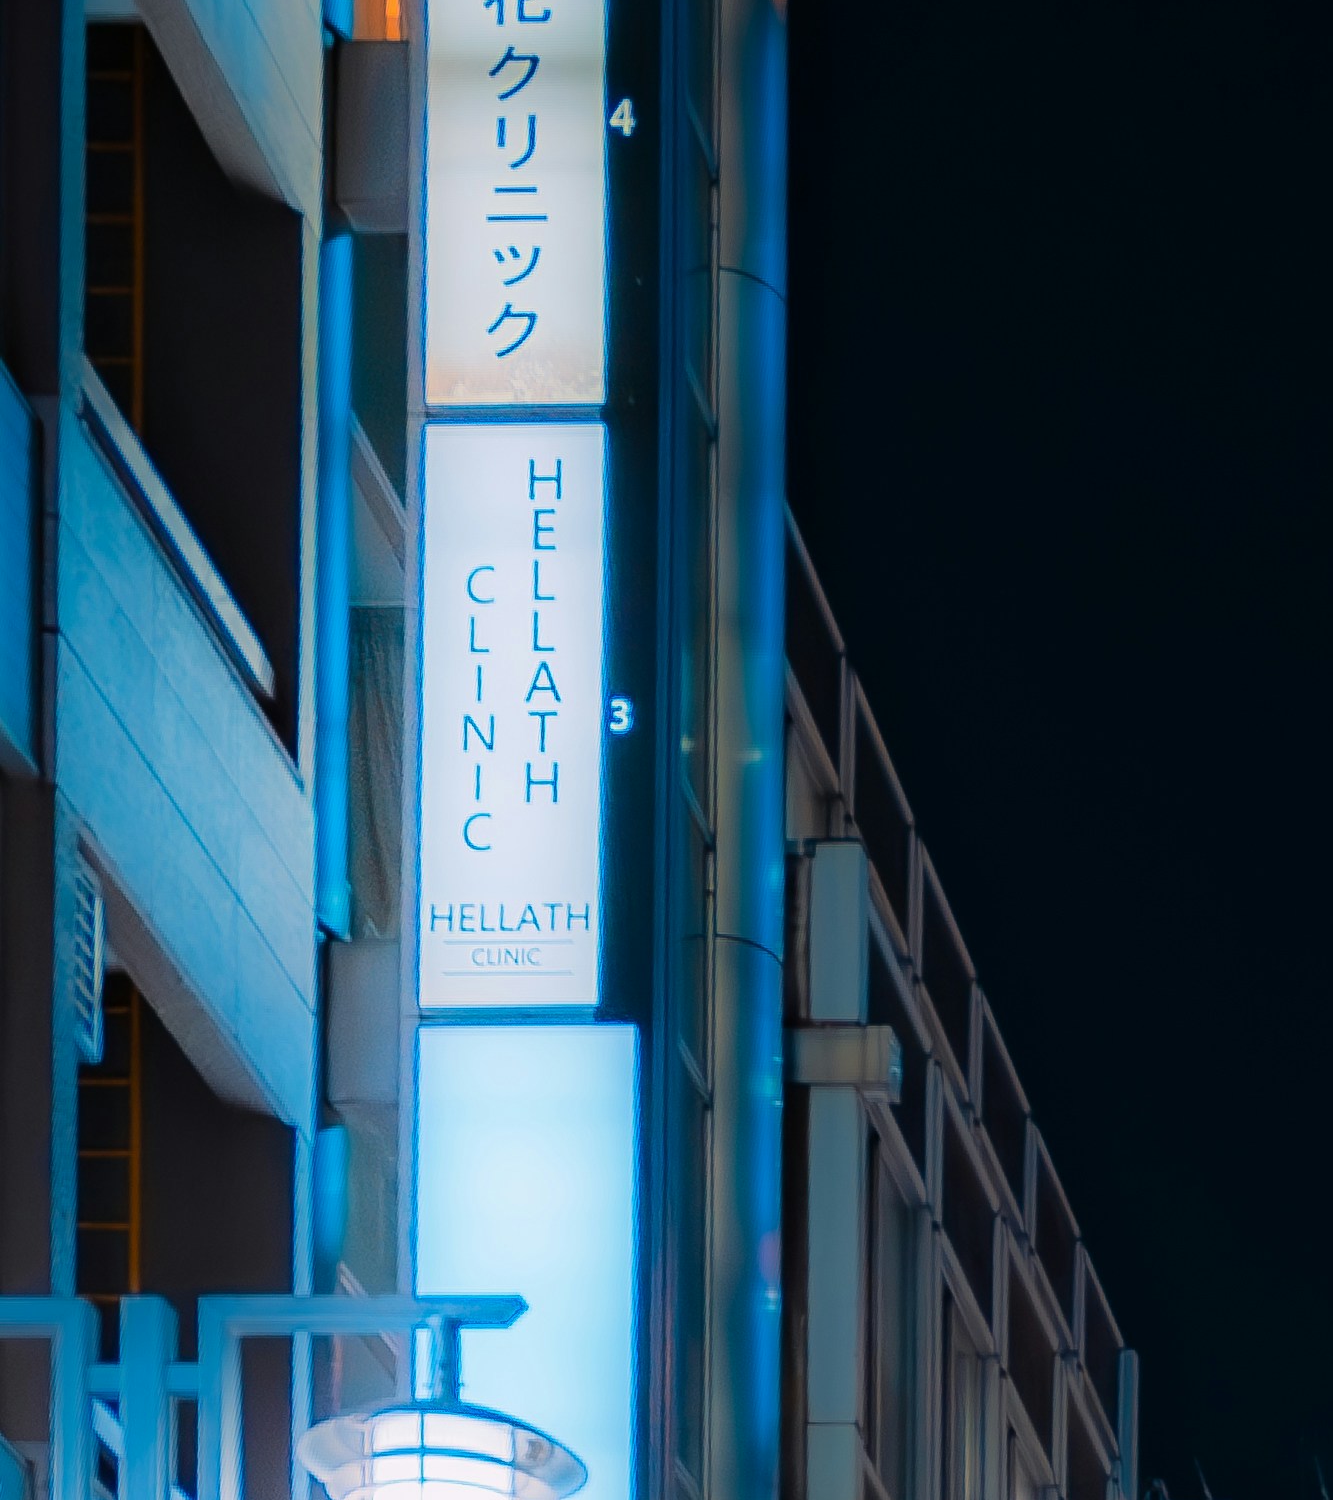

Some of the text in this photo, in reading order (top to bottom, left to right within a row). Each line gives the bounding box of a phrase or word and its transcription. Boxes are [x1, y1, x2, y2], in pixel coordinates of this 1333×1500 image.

[609, 101, 634, 135] 4
[525, 458, 563, 804] HELLATH
[463, 566, 496, 853] CLINIC
[609, 699, 632, 733] 3
[428, 902, 592, 933] HELLATH
[470, 946, 541, 967] CLINIC
